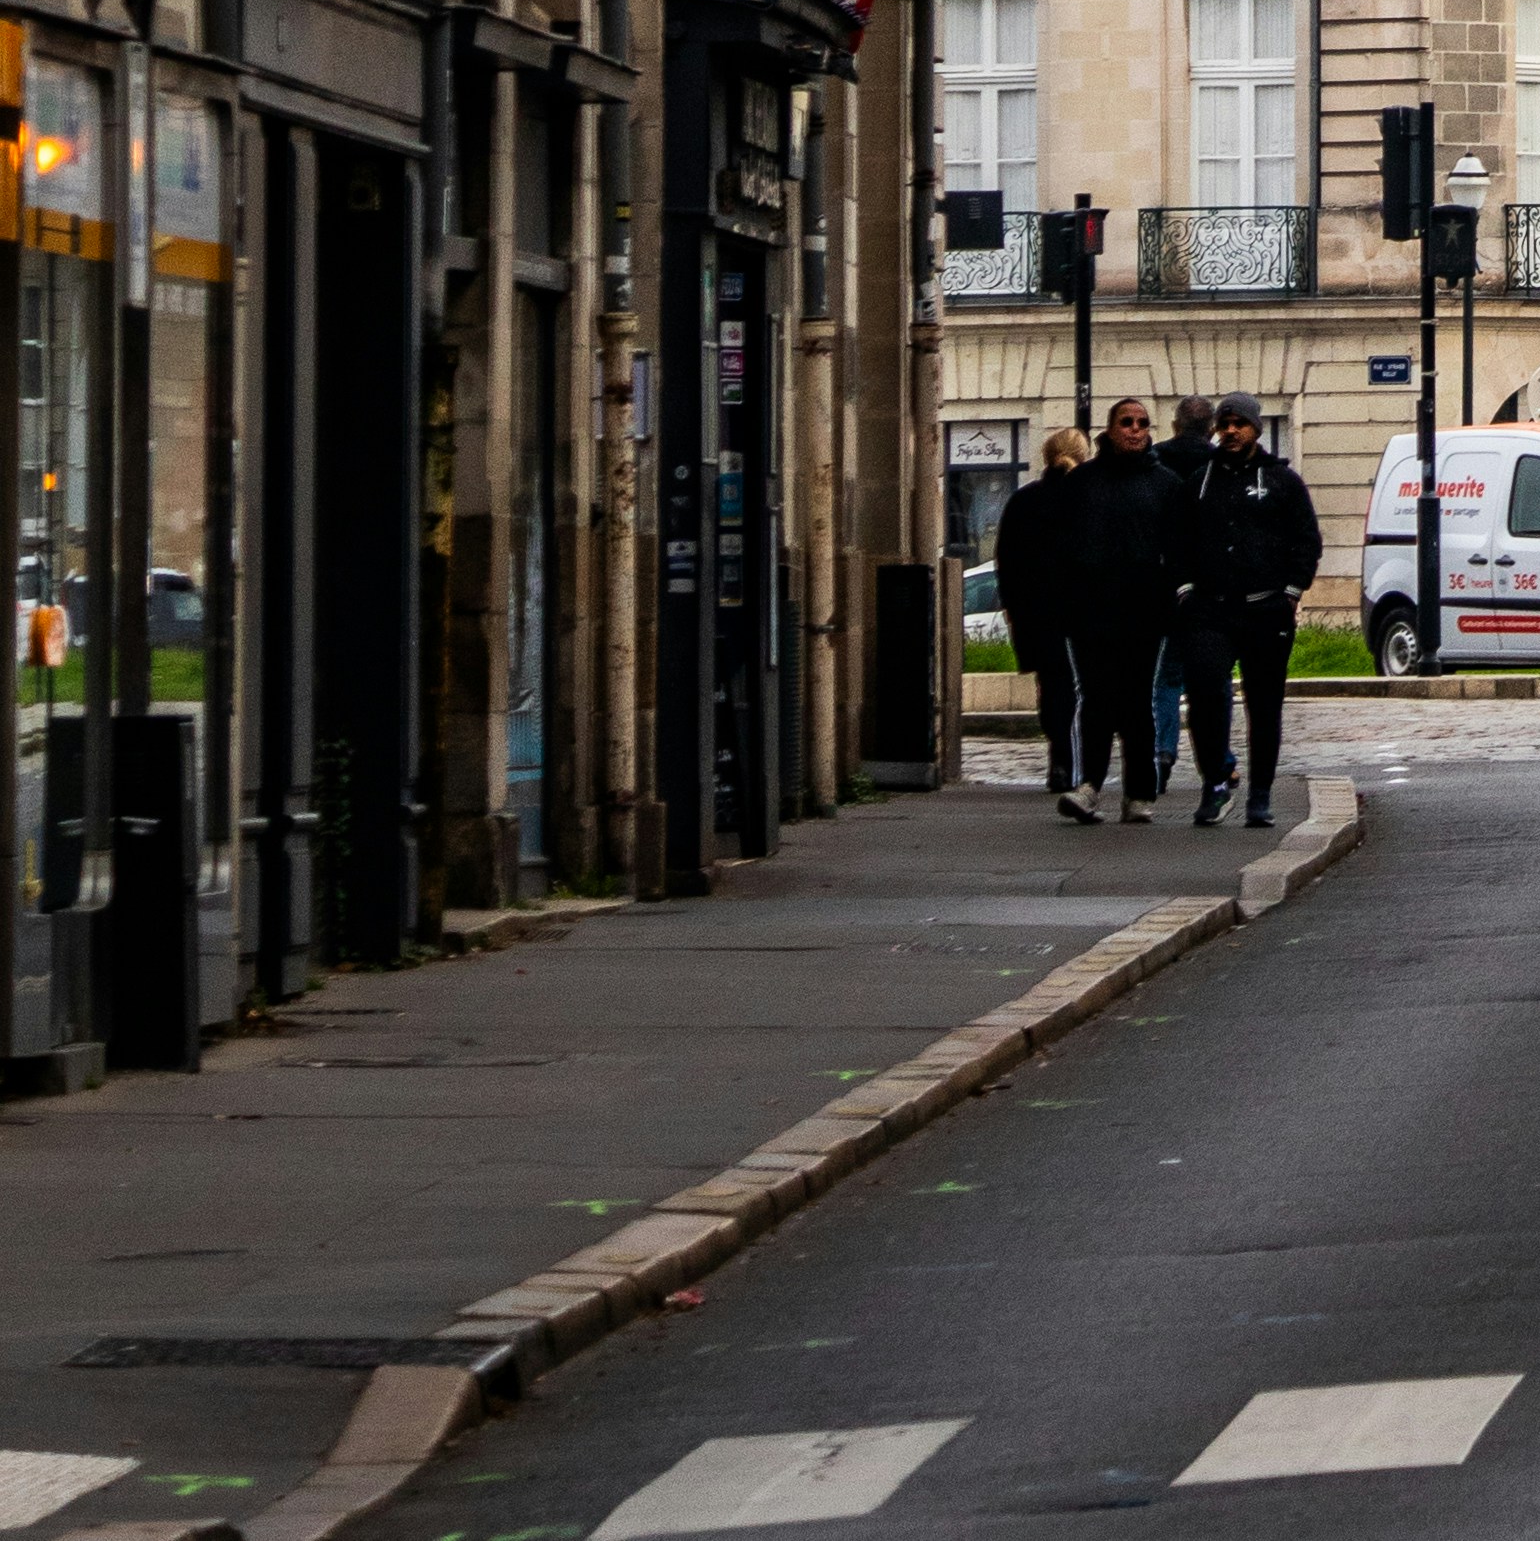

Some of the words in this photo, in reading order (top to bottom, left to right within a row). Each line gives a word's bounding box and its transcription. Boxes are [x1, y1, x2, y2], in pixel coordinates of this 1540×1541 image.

[984, 442, 1006, 461] Shop
[1398, 475, 1485, 498] mauerite
[1448, 574, 1466, 590] 3€
[1513, 574, 1538, 590] 36€
